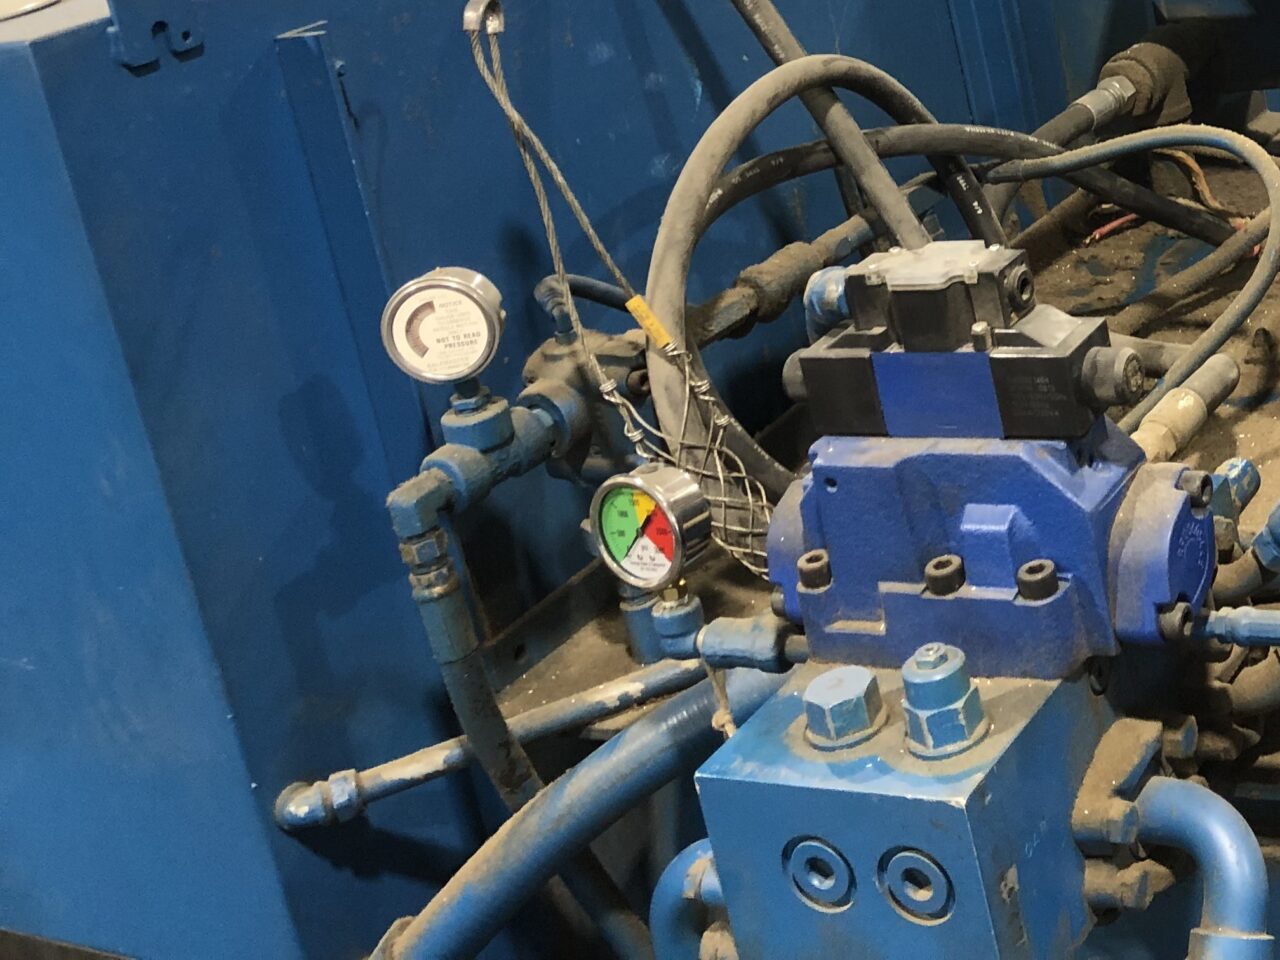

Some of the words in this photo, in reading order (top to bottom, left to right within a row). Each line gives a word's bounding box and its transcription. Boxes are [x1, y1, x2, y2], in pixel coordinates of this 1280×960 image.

[435, 336, 450, 344] NOT
[463, 331, 481, 339] READ
[444, 338, 478, 349] PRESSURE
